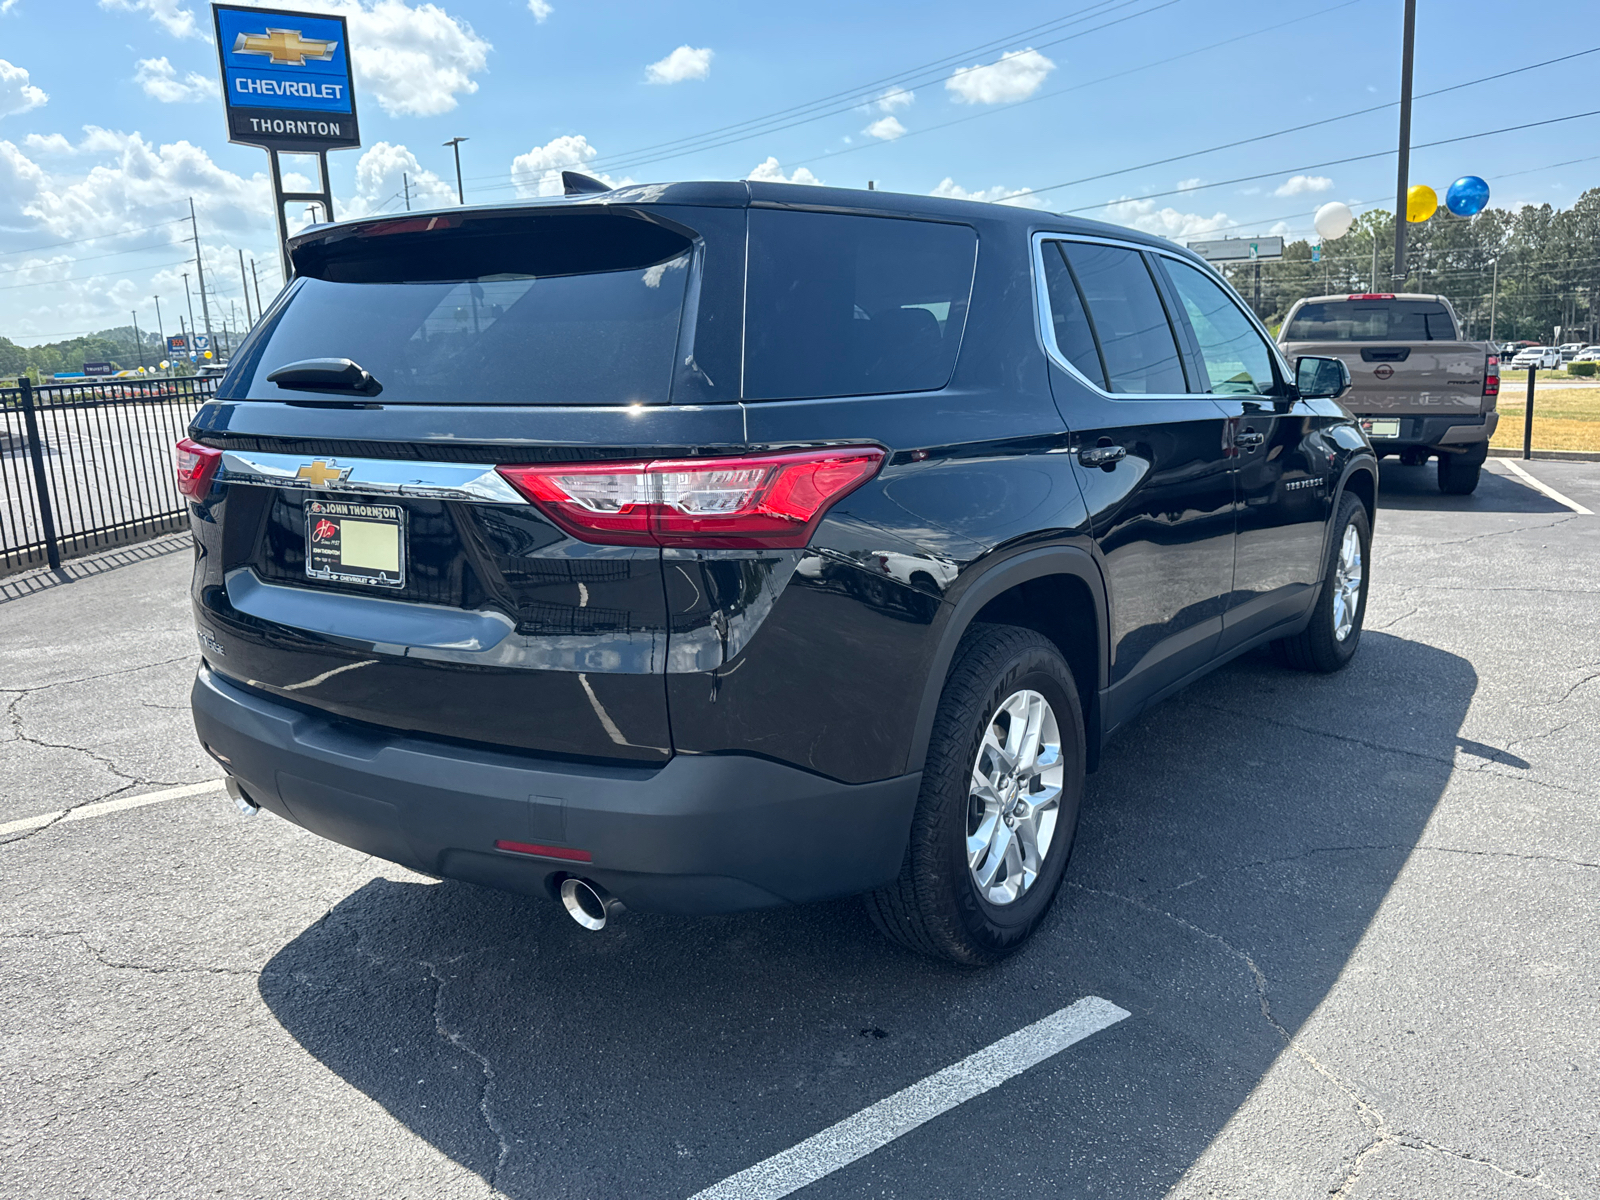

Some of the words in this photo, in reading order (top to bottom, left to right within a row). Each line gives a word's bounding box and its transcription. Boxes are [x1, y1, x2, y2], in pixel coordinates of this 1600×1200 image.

[235, 77, 344, 99] CHEVROLET
[249, 118, 341, 136] THORNTON
[326, 503, 348, 515] JOHN
[349, 505, 397, 519] THORNTON
[340, 575, 368, 584] CHEVROLET
